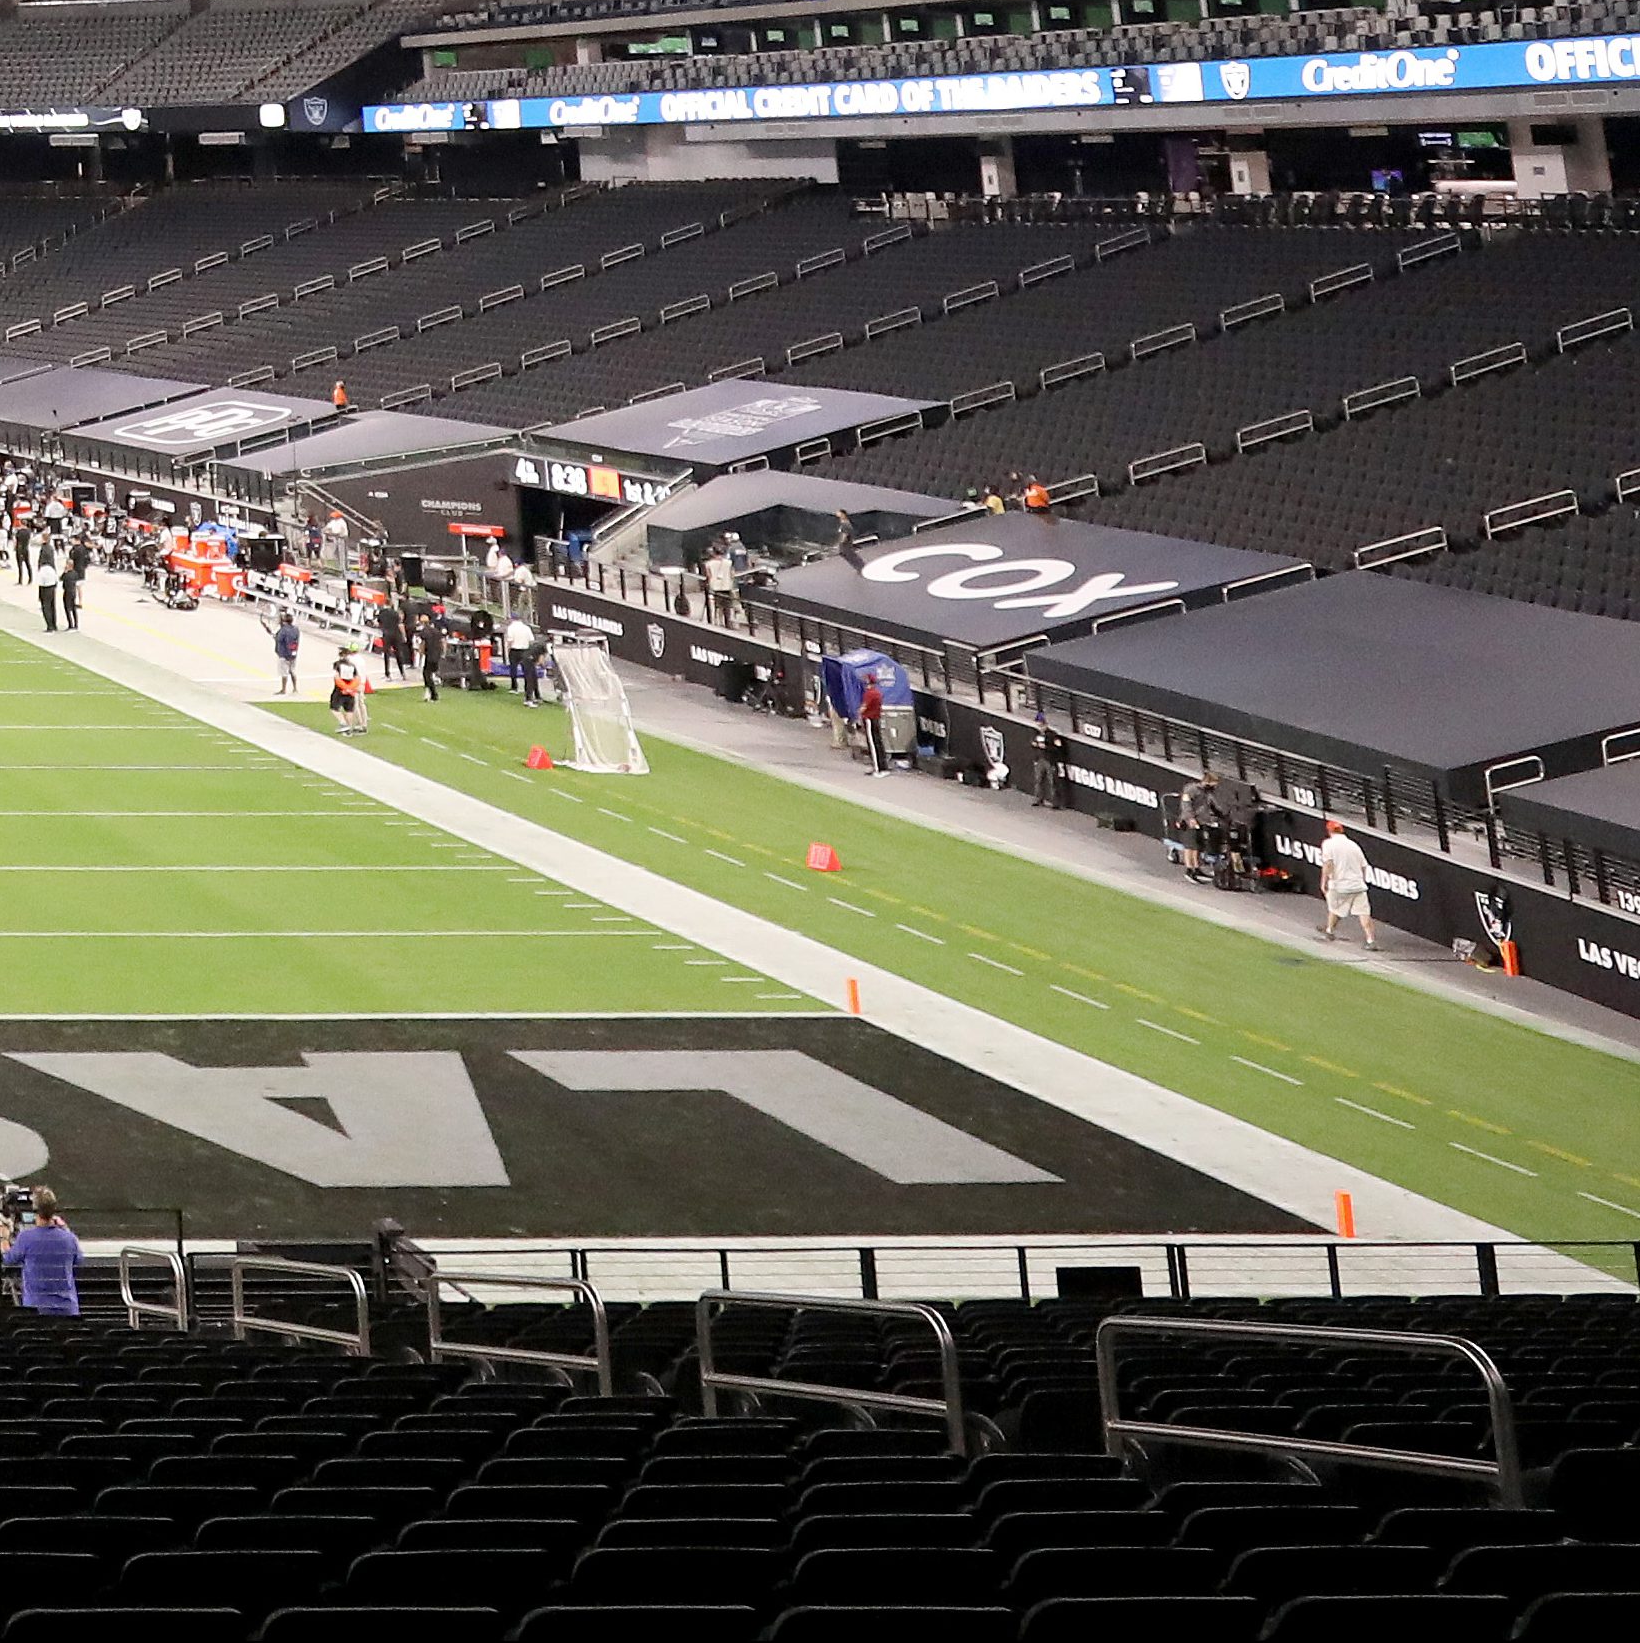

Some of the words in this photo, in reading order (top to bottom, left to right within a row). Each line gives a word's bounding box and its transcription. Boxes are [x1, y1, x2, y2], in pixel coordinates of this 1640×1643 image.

[661, 91, 755, 122] OFFICIAL
[833, 82, 899, 115] CARD
[900, 80, 935, 112] OF
[421, 499, 483, 512] CHAMPIONS
[861, 543, 1180, 619] COX
[1065, 763, 1106, 792] VEGAS
[1105, 775, 1159, 808] RAIDERS
[1292, 786, 1317, 807] 138
[1275, 834, 1303, 860] LAS
[1365, 865, 1419, 901] AIDERS
[1577, 938, 1614, 970] LAS
